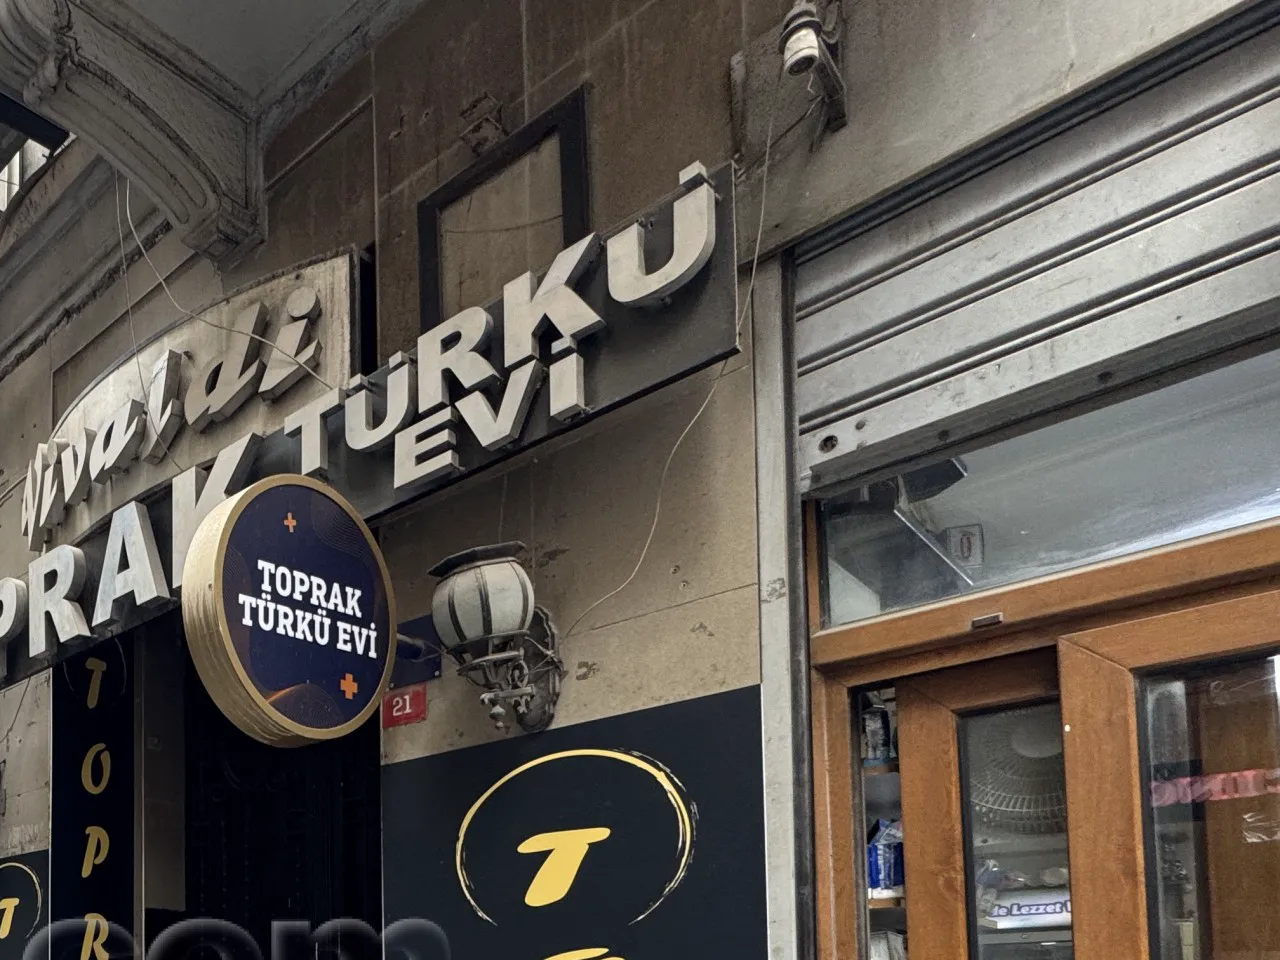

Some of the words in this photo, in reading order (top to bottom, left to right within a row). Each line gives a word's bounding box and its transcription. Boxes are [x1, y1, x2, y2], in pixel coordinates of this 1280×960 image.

[394, 334, 586, 490] EVİ
[257, 559, 362, 618] TOPRAK
[238, 592, 331, 646] TÜRKÜ
[336, 622, 378, 659] EVİ
[392, 694, 412, 717] 21
[1010, 902, 1063, 916] Lezzet
